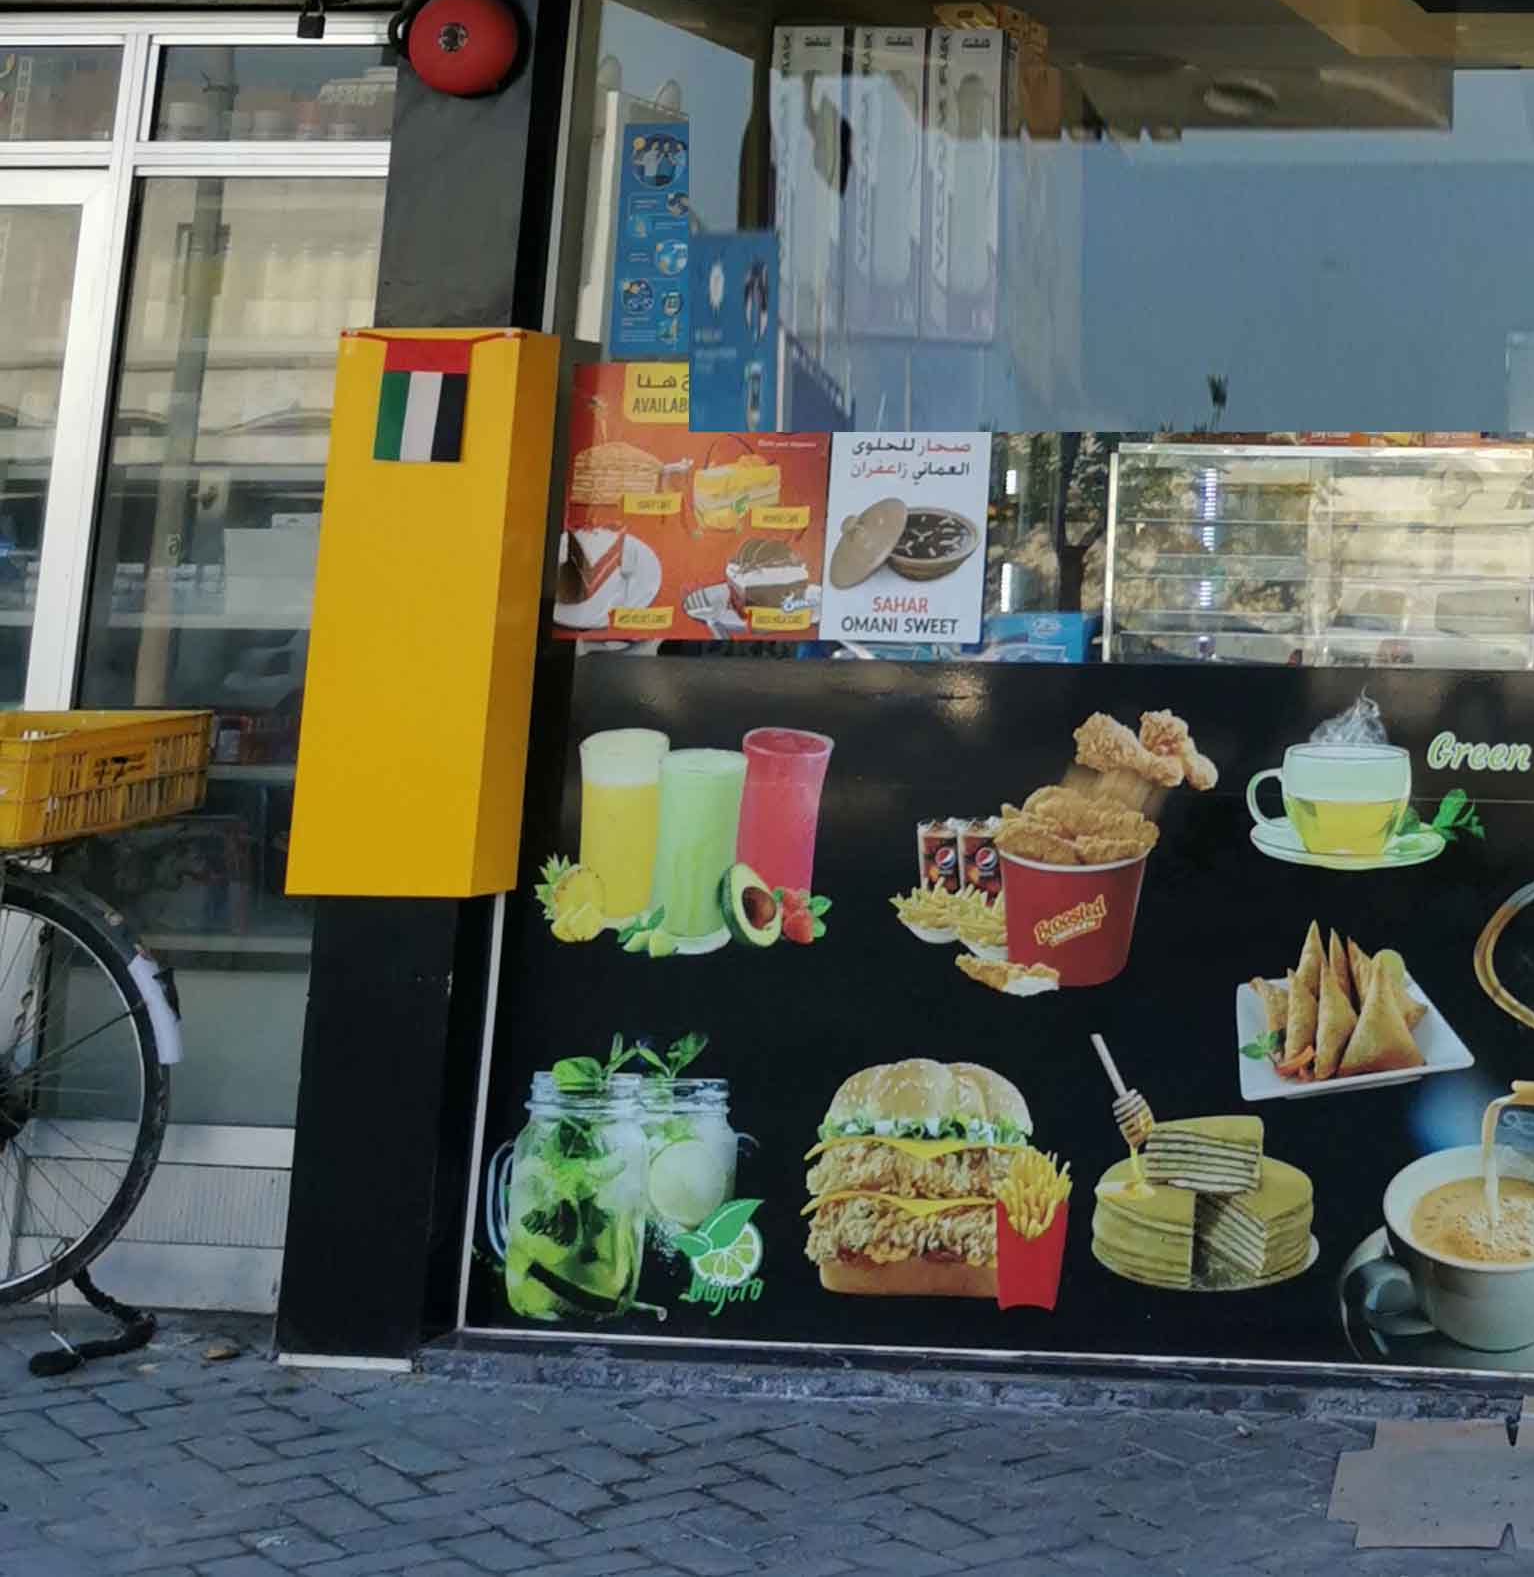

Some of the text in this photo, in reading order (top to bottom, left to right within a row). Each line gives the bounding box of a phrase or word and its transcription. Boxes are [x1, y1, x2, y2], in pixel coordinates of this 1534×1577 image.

[872, 596, 928, 614] SAHAR
[840, 616, 959, 635] OMANI SWEET
[1427, 731, 1532, 771] Green
